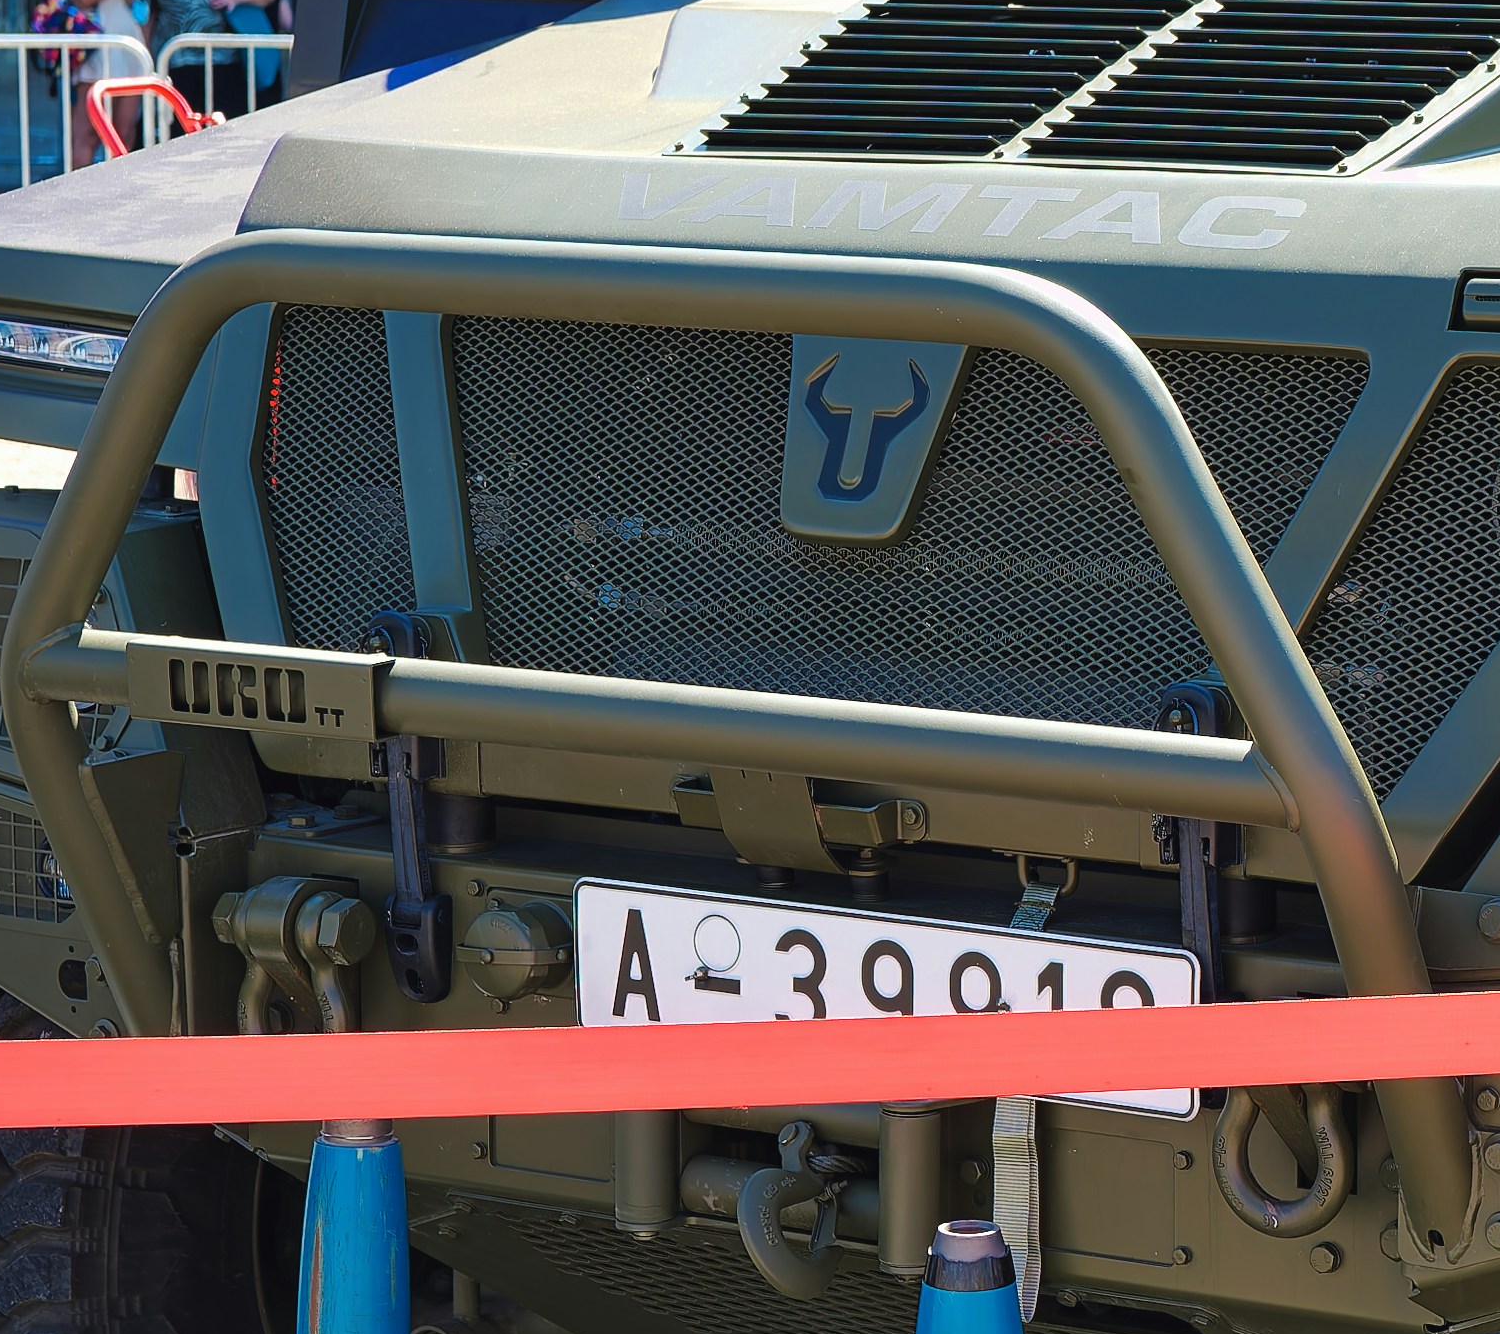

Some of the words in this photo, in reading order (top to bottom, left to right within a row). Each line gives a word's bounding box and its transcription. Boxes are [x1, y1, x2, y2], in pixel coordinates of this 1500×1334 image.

[618, 173, 1307, 251] VAMTAC
[168, 658, 307, 724] URO
[314, 706, 345, 727] TT
